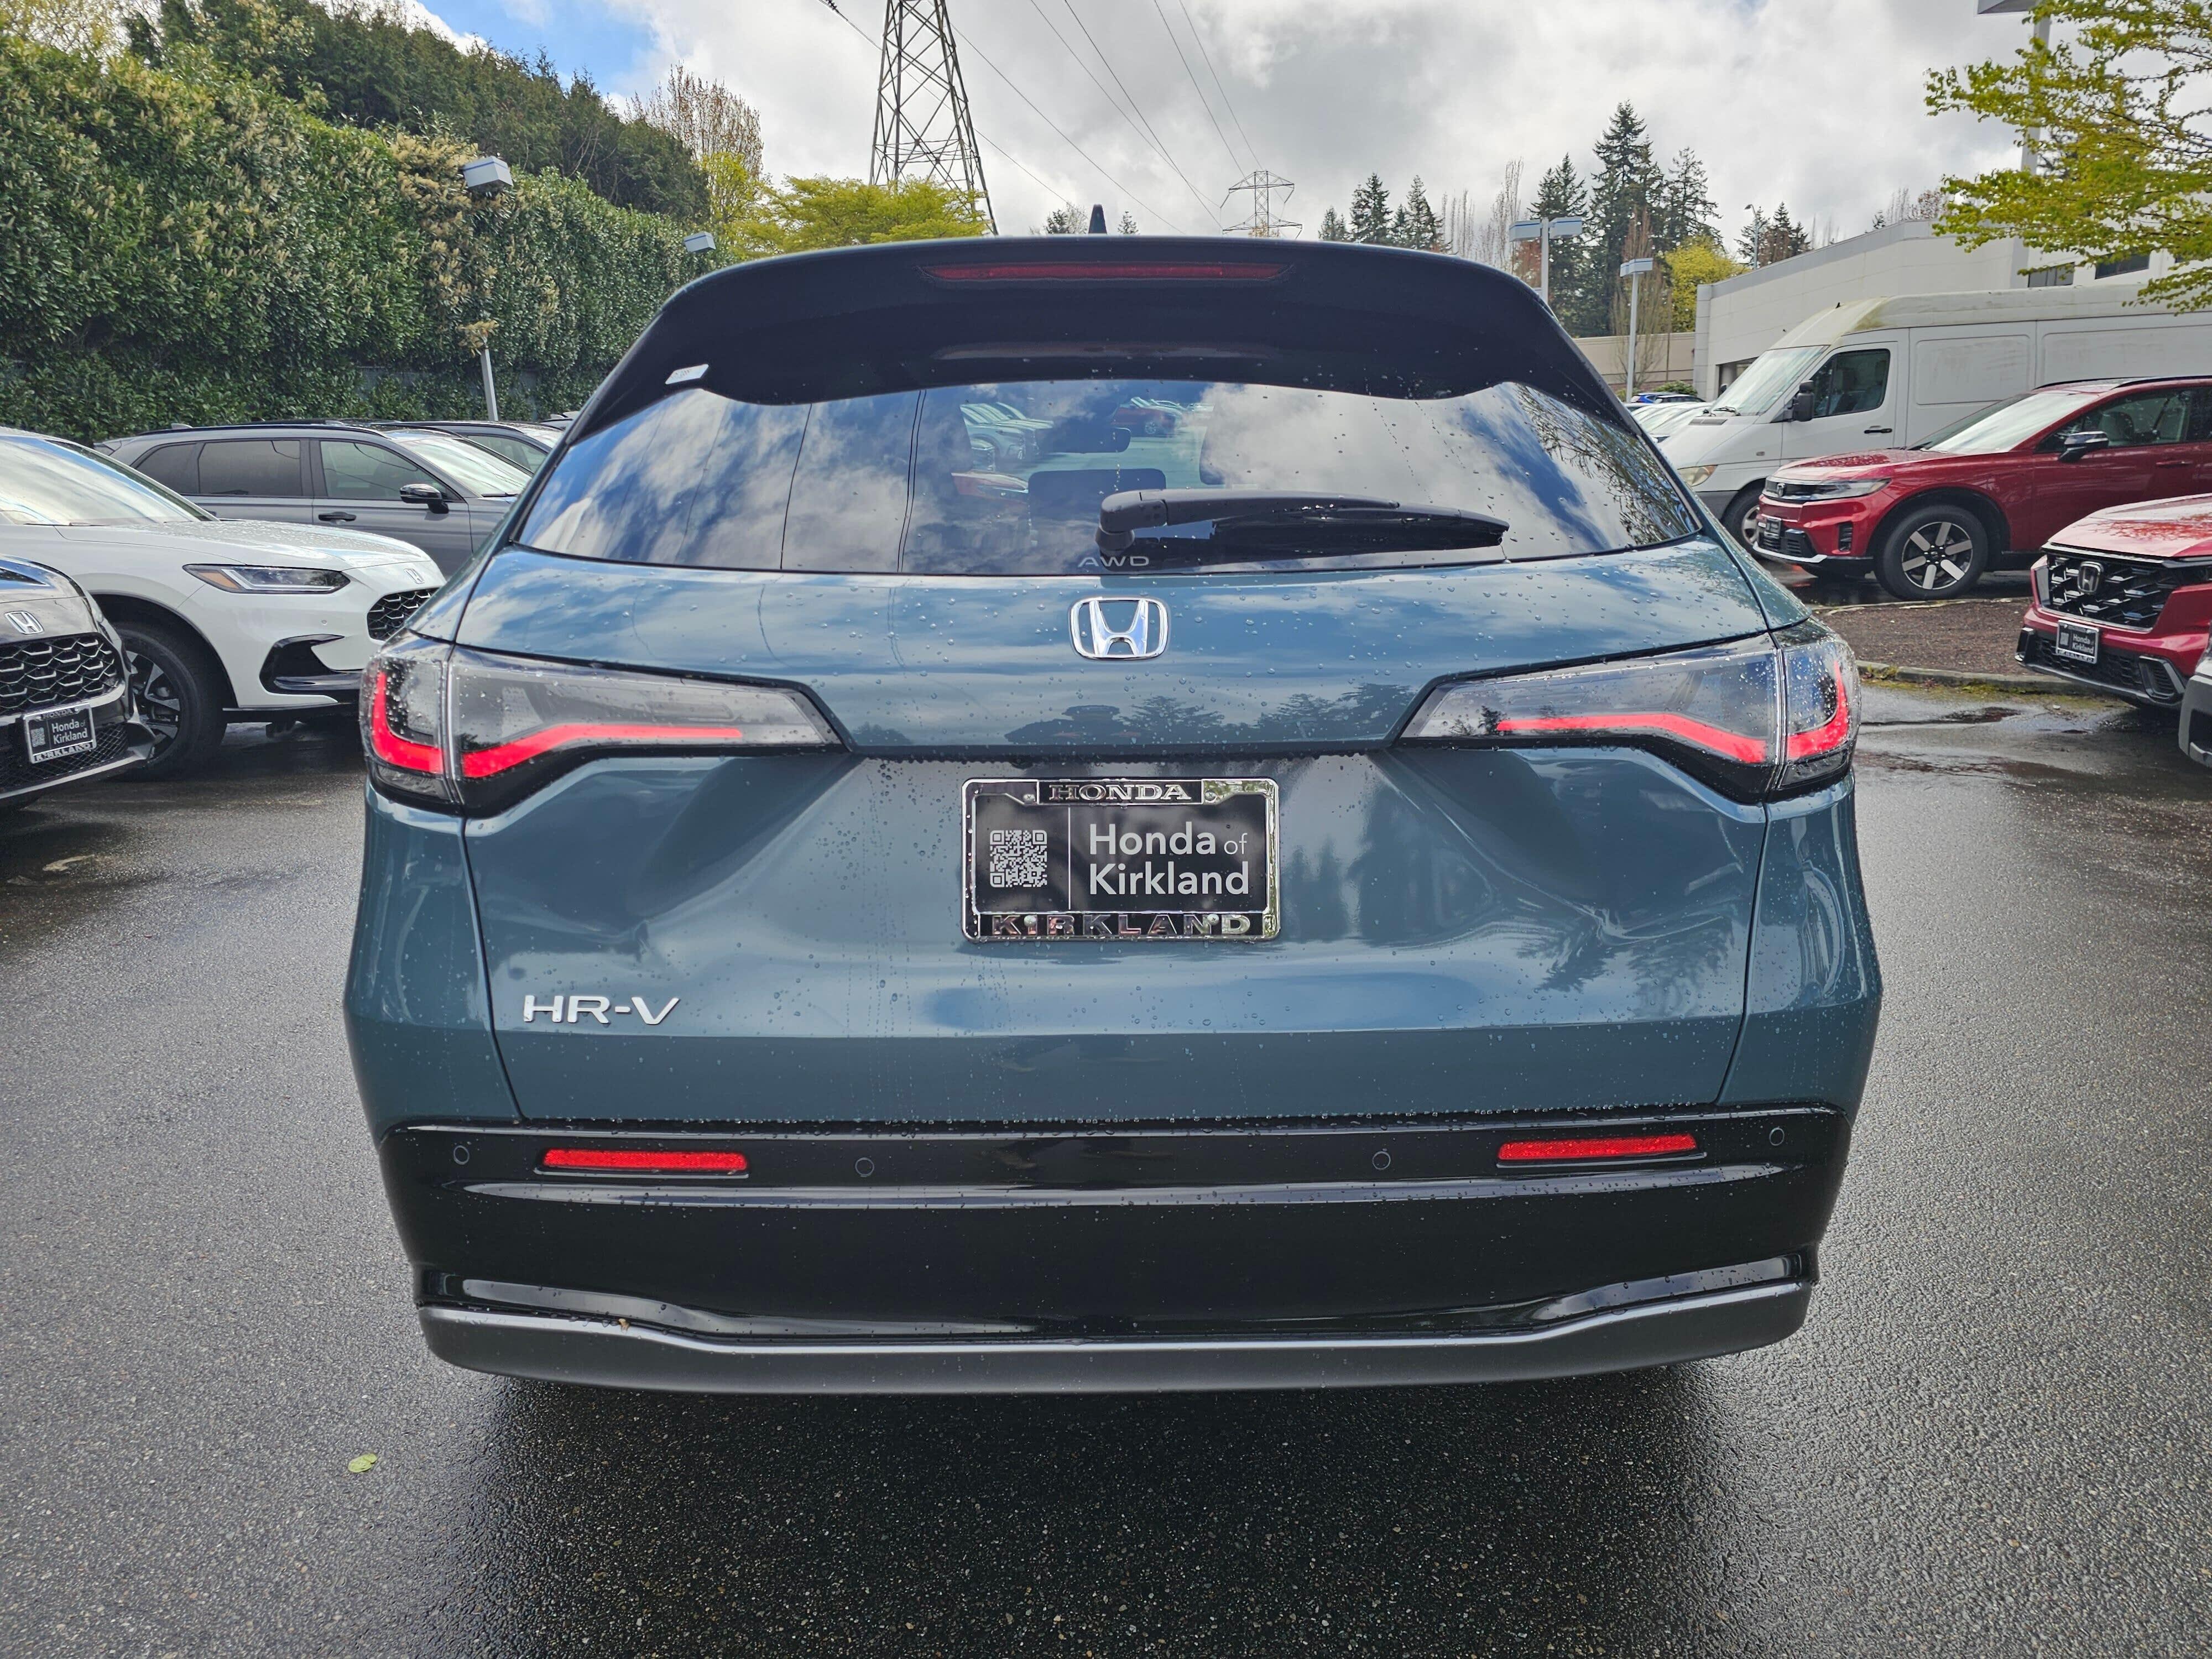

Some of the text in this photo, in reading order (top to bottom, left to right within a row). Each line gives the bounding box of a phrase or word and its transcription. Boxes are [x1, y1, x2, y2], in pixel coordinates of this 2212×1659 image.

[1078, 556, 1150, 567] AWD
[51, 719, 79, 733] Honda
[53, 728, 88, 744] Kirkland
[1048, 784, 1192, 801] HONDA
[1090, 821, 1248, 855] Honda of
[1090, 861, 1249, 895] Kirkland
[523, 995, 680, 1025] HR-V
